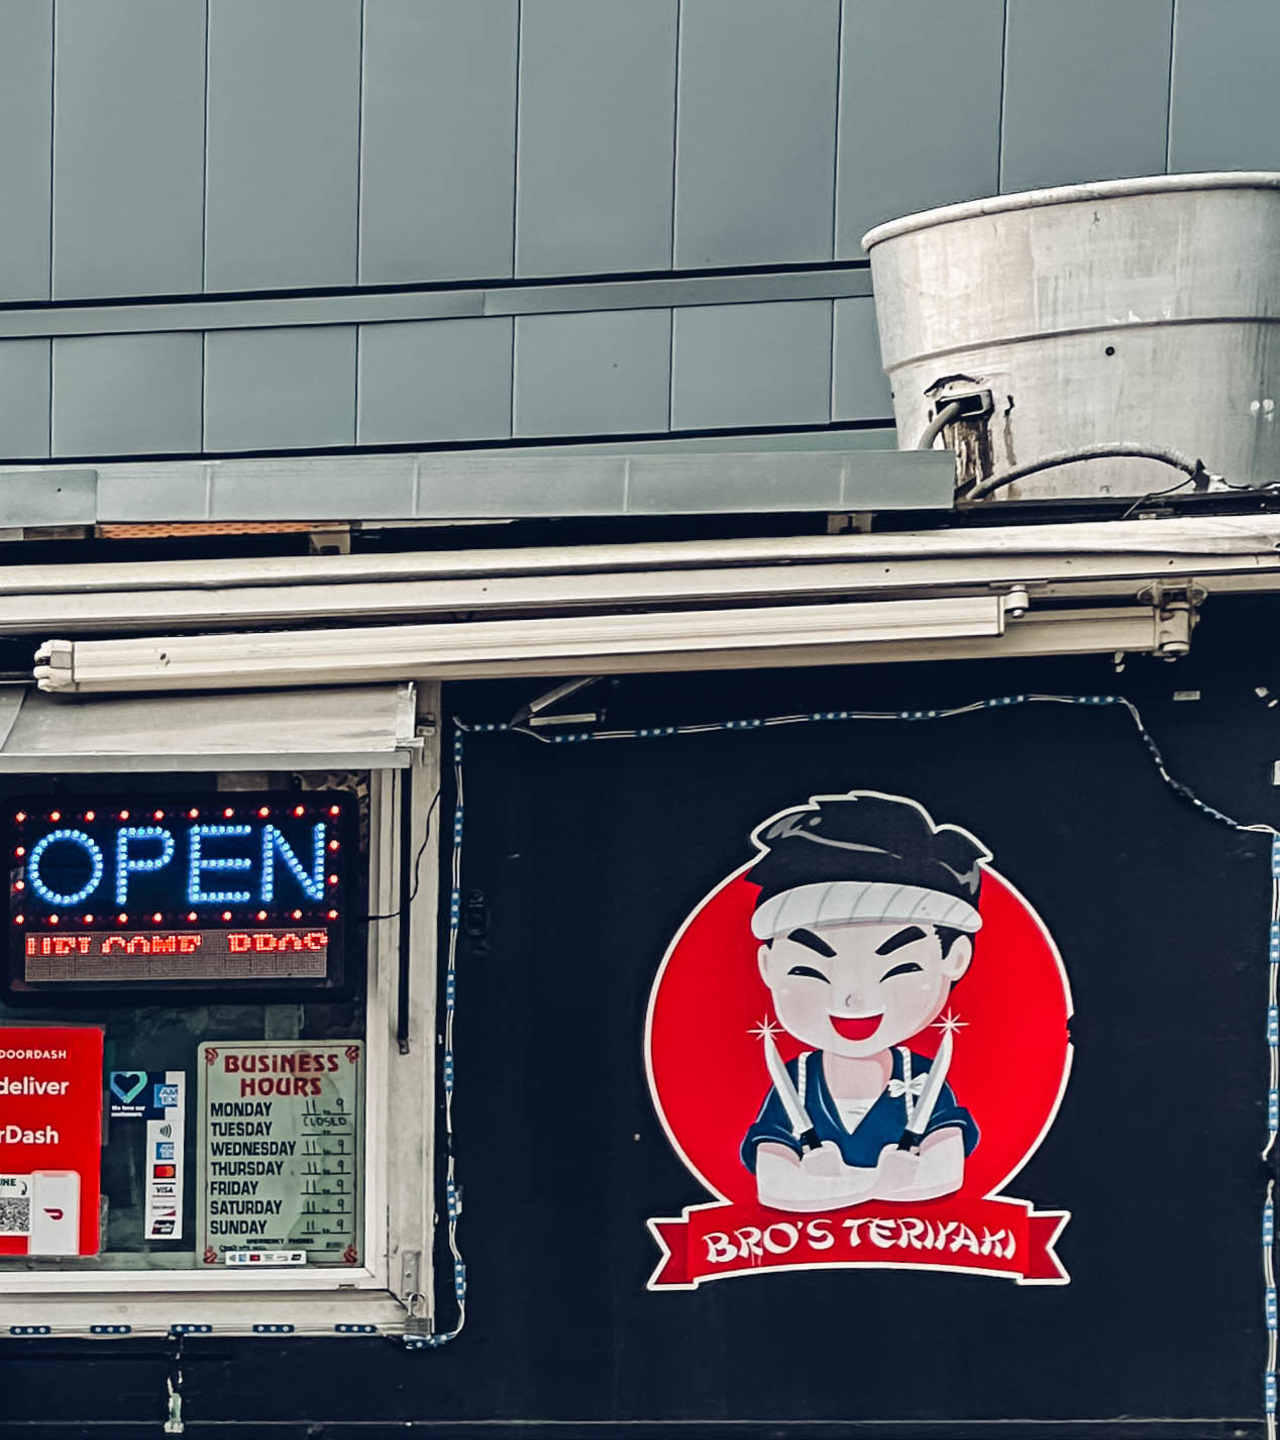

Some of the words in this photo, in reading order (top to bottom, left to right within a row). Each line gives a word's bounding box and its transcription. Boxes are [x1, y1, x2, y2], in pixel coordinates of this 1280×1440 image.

[28, 822, 325, 905] OPEN
[224, 1054, 340, 1073] BUSINESS
[240, 1077, 322, 1097] HOURS
[210, 1102, 272, 1117] MONDAY
[336, 1098, 344, 1115] 9
[211, 1122, 272, 1137] TUESDAY
[303, 1116, 347, 1128] CLOSED
[211, 1141, 296, 1156] WEDNESDAY
[211, 1161, 284, 1176] THURSDAY
[211, 1181, 259, 1195] FRIDAY
[211, 1200, 282, 1215] SATURDAY
[211, 1220, 268, 1235] SUNDAY
[701, 1218, 836, 1263] BRO'S
[842, 1217, 1017, 1260] TERIYAKI
